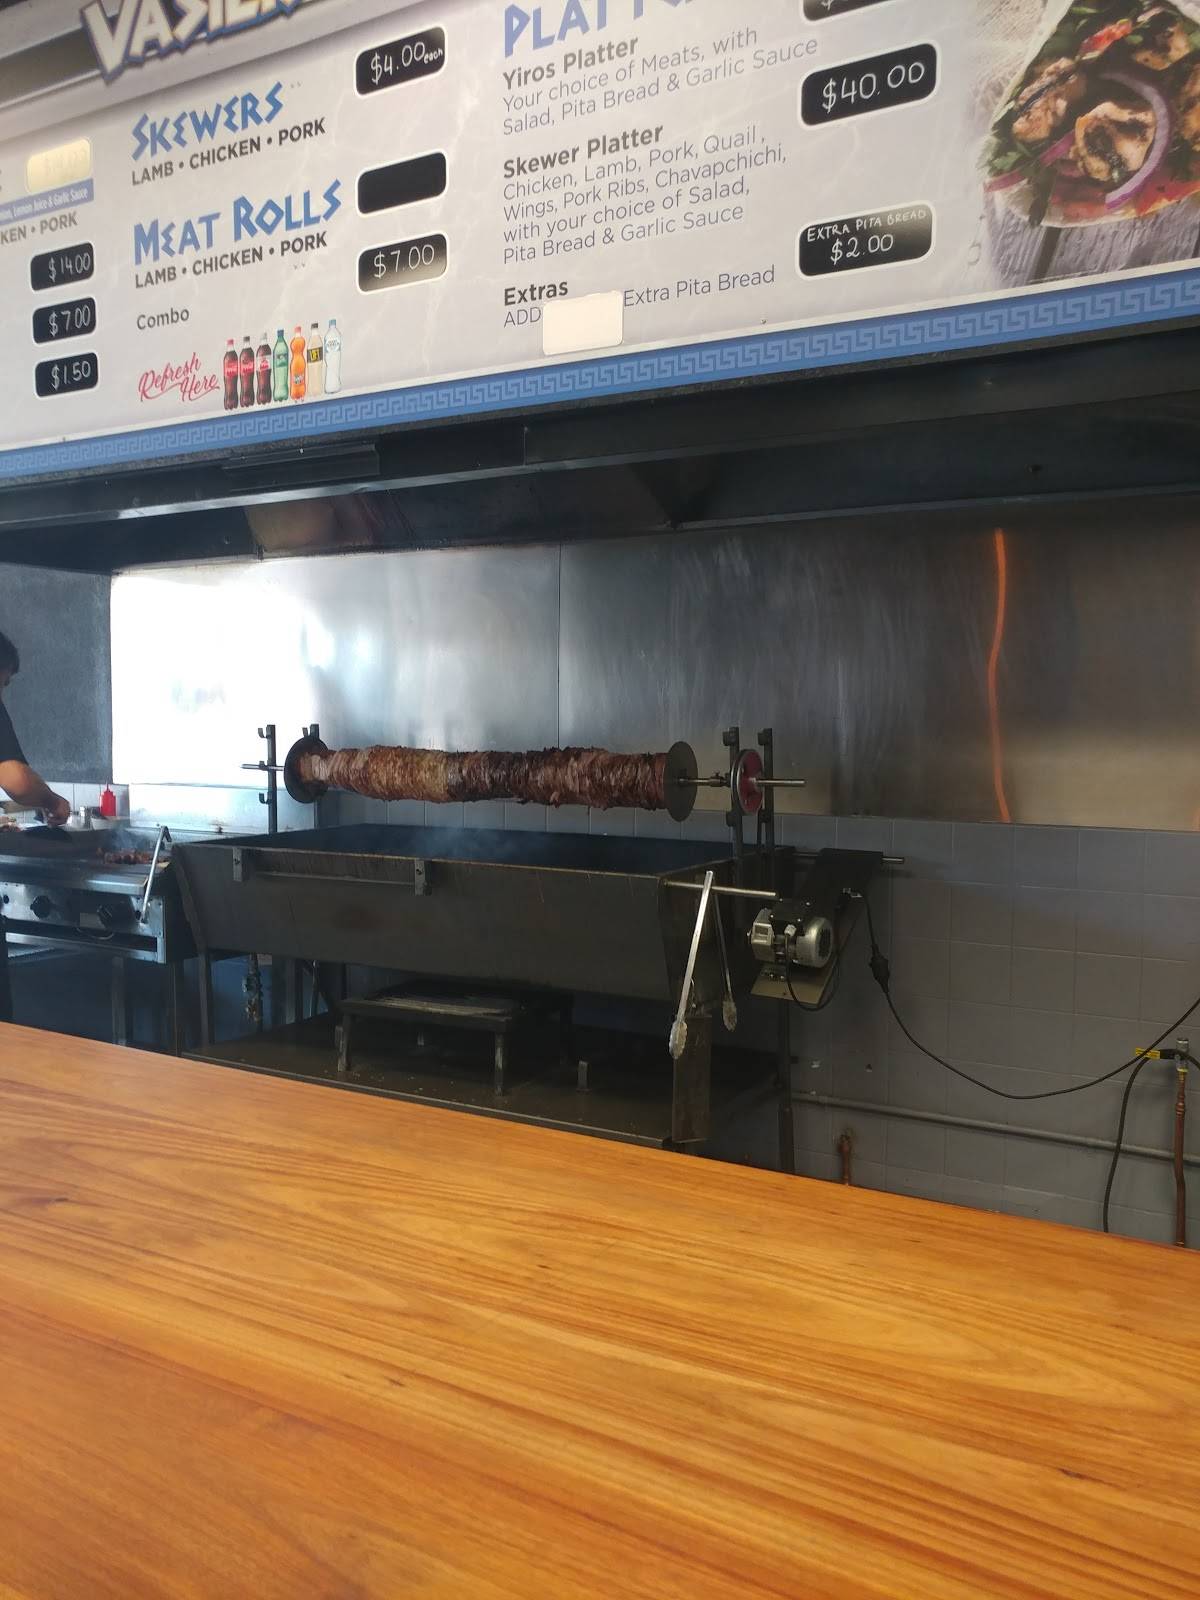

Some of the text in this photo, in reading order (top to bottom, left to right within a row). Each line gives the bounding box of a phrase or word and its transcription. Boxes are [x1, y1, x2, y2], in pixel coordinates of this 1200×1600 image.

[371, 41, 443, 85] $4.00 each
[503, 37, 639, 90] Yiros Platter
[503, 26, 757, 113] Your choice of Meats, with
[503, 38, 818, 136] Salad, Pita Bread & Garlic Sauce
[822, 61, 925, 113] $40.00
[132, 81, 283, 161] SKEWERS
[132, 117, 326, 186] LAMB CHICKEN PORK
[503, 125, 664, 179] Skewer Platter
[503, 173, 577, 201] Chicken,
[585, 154, 641, 182] Lamb,
[649, 141, 699, 167] Pork,
[503, 143, 787, 222] Wings, Pork Ribs, Chavapchichi,
[503, 176, 750, 243] with your choice of Salad,
[40, 211, 78, 235] PORK
[134, 179, 342, 265] MEAT ROLLS
[503, 205, 744, 265] Pita Bread & Garlic Sauce
[807, 209, 926, 242] EXTRA PITA BREAD
[830, 234, 894, 265] $2.00
[135, 231, 327, 289] LAMB CHICKEN PORK
[136, 308, 190, 330] Combo
[503, 264, 776, 328] ADD Extra Pita Bread
[504, 281, 568, 306] Extras
[138, 352, 202, 402] Refresh
[180, 374, 220, 402] Here
